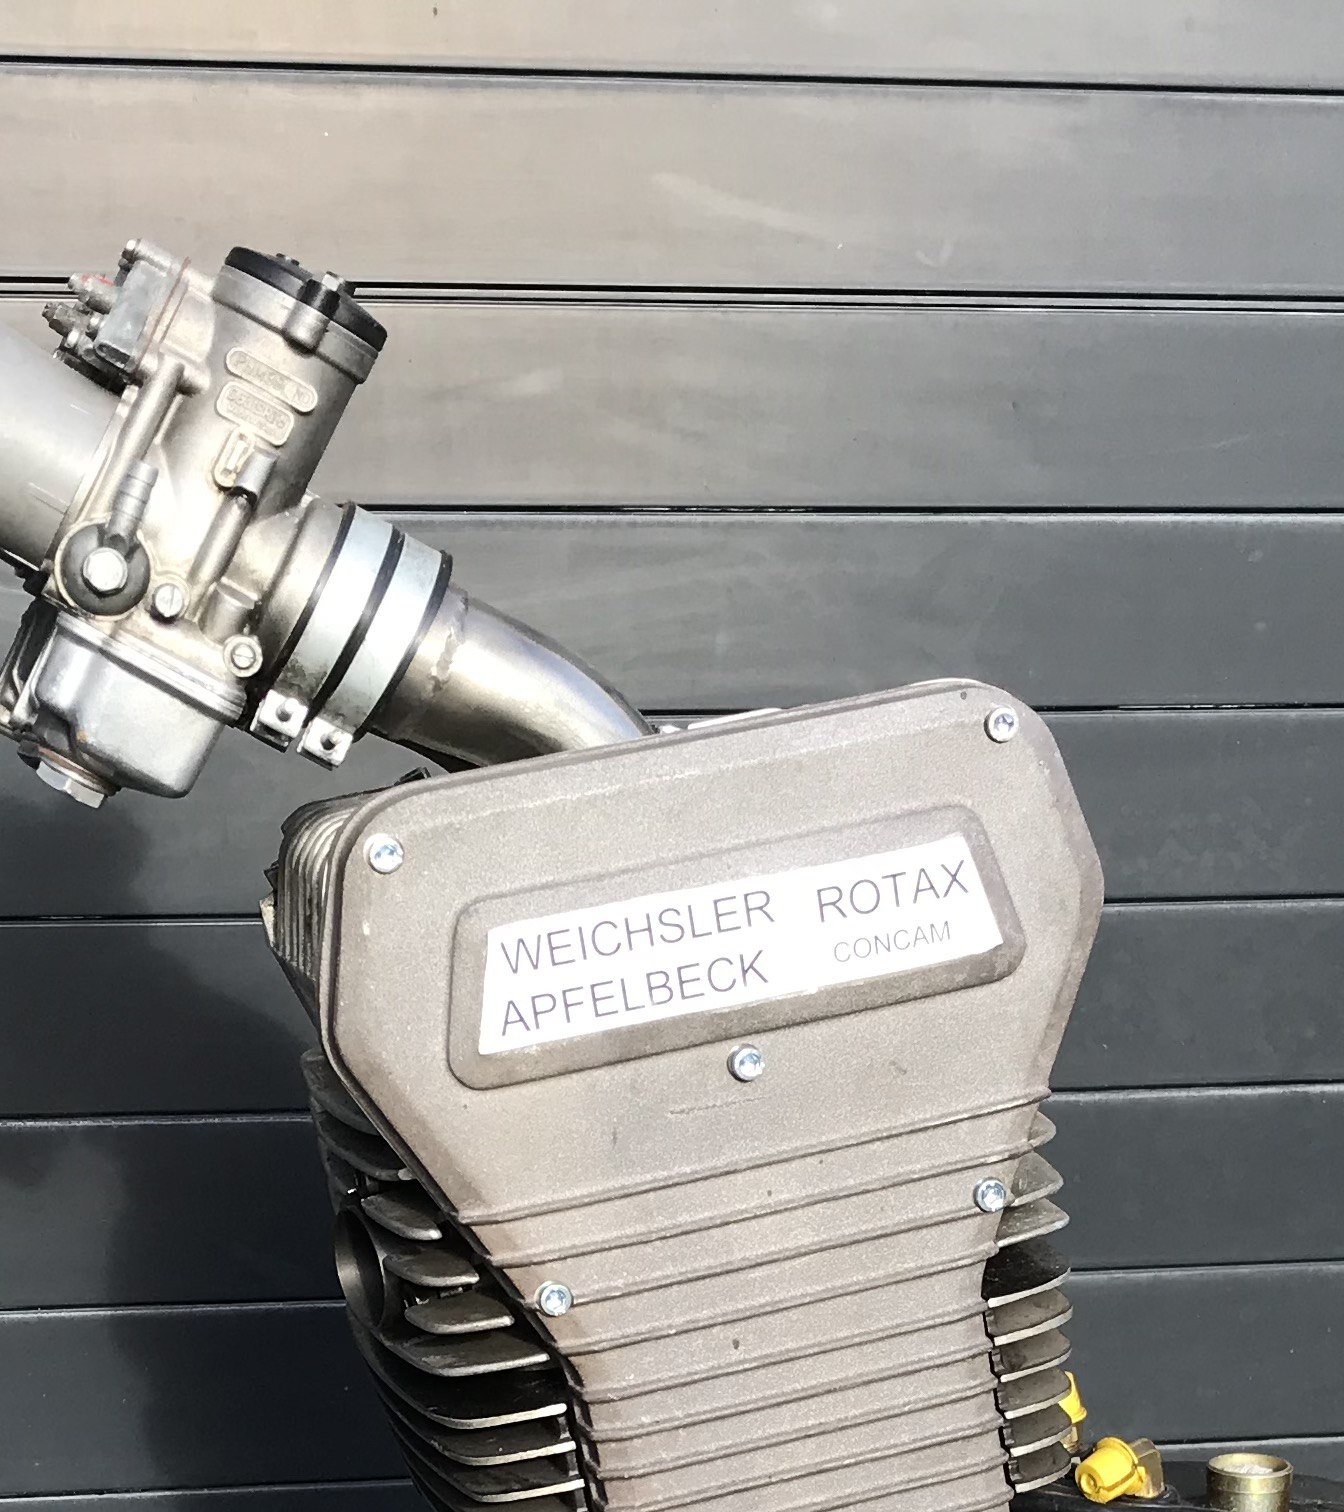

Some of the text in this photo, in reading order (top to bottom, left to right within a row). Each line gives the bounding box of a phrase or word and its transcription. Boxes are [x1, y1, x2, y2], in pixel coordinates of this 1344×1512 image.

[500, 859, 969, 974] WEICHSLER ROTAX
[833, 920, 950, 962] CONCAM
[501, 949, 768, 1036] APFELBECK
